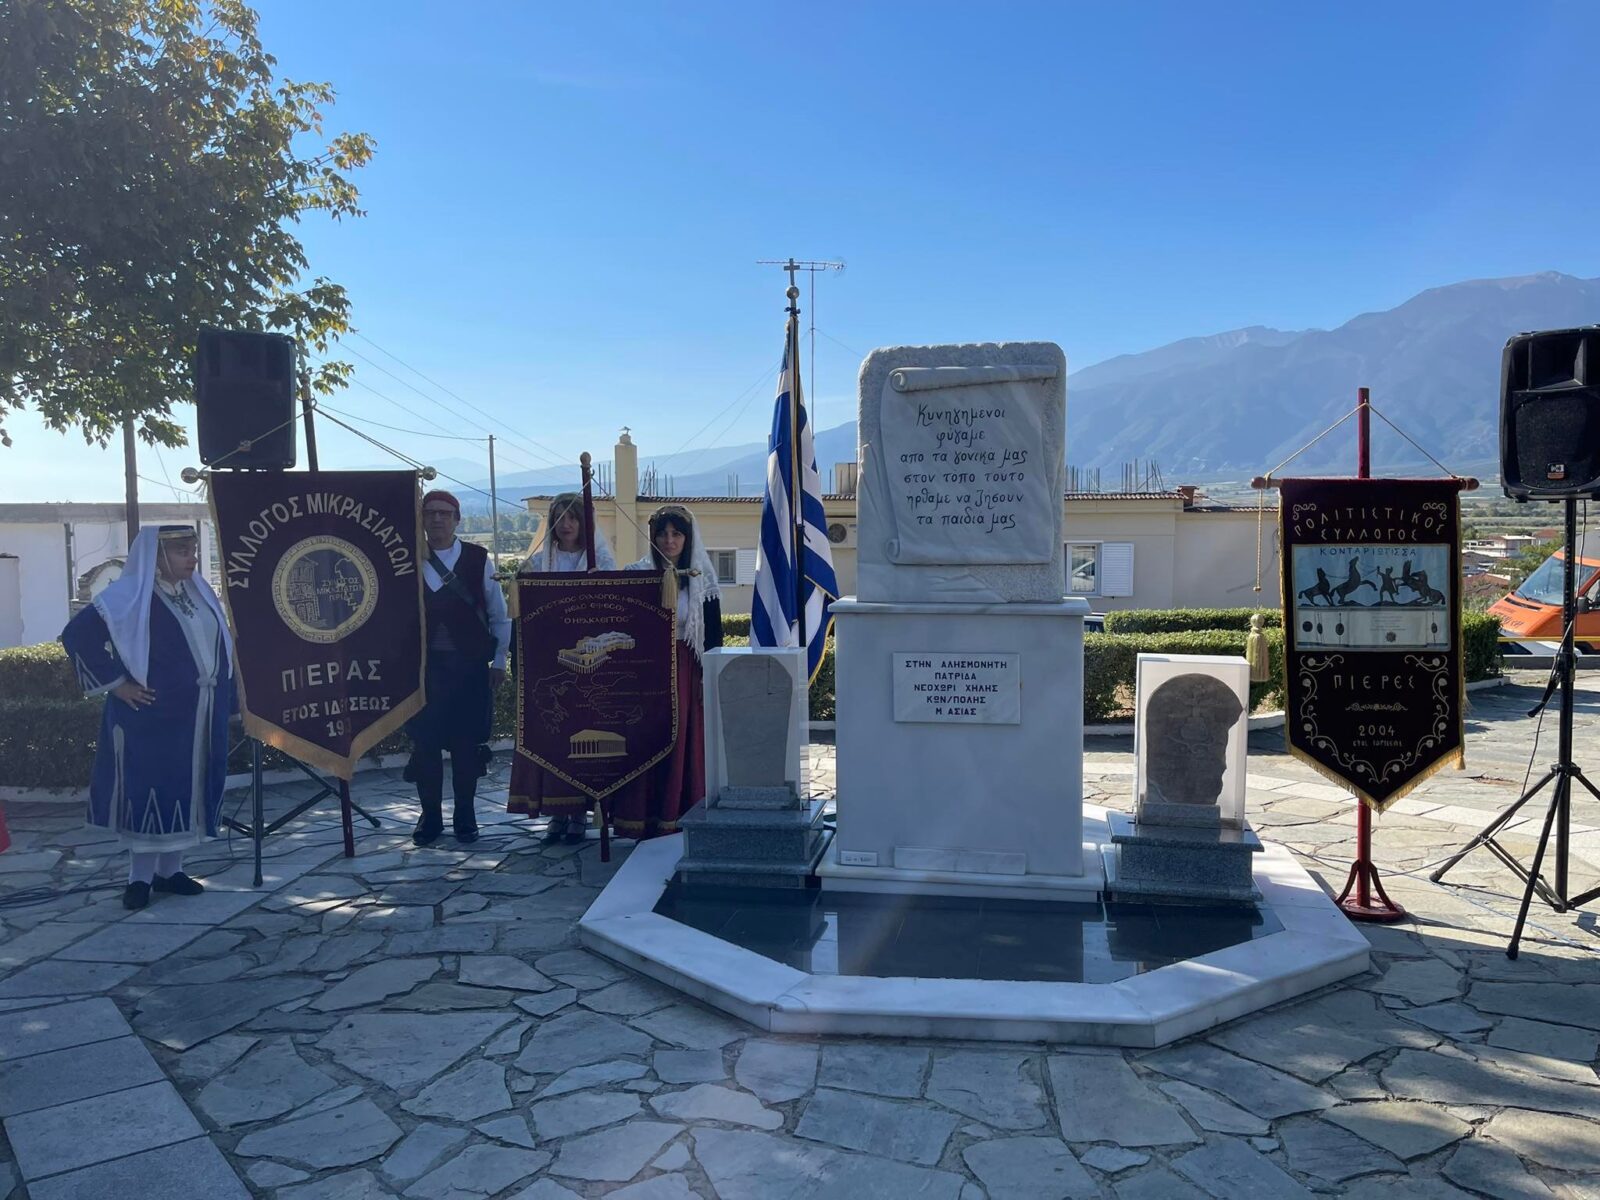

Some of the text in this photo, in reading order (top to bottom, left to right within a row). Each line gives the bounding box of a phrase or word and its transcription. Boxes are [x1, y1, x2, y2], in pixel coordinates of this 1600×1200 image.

[932, 452, 948, 462] τα
[997, 448, 1028, 468] μας
[904, 473, 936, 483] στον
[956, 494, 971, 503] να
[916, 515, 933, 525] τα
[986, 513, 1016, 534] μας
[228, 493, 415, 588] ΣΥΛΛΟΓΟΣ ΜΙΚΡΑΣΙΑΤΩΝ
[905, 660, 1007, 669] ΣΤΗΝ ΑΛΗΣΜΟΝΗΤΗ
[934, 672, 977, 680] ΠΑΤΡΙΔΑ
[914, 684, 998, 692] ΝΕΟΧΩΡΙ ΧΗΛΗΣ
[926, 695, 986, 704] ΚΩΝ/ΠΟΛΗΣ
[282, 702, 320, 724] ΕΤΟΣ
[947, 707, 977, 715] ΑΣΙΑΣ
[1358, 725, 1395, 736] 2004
